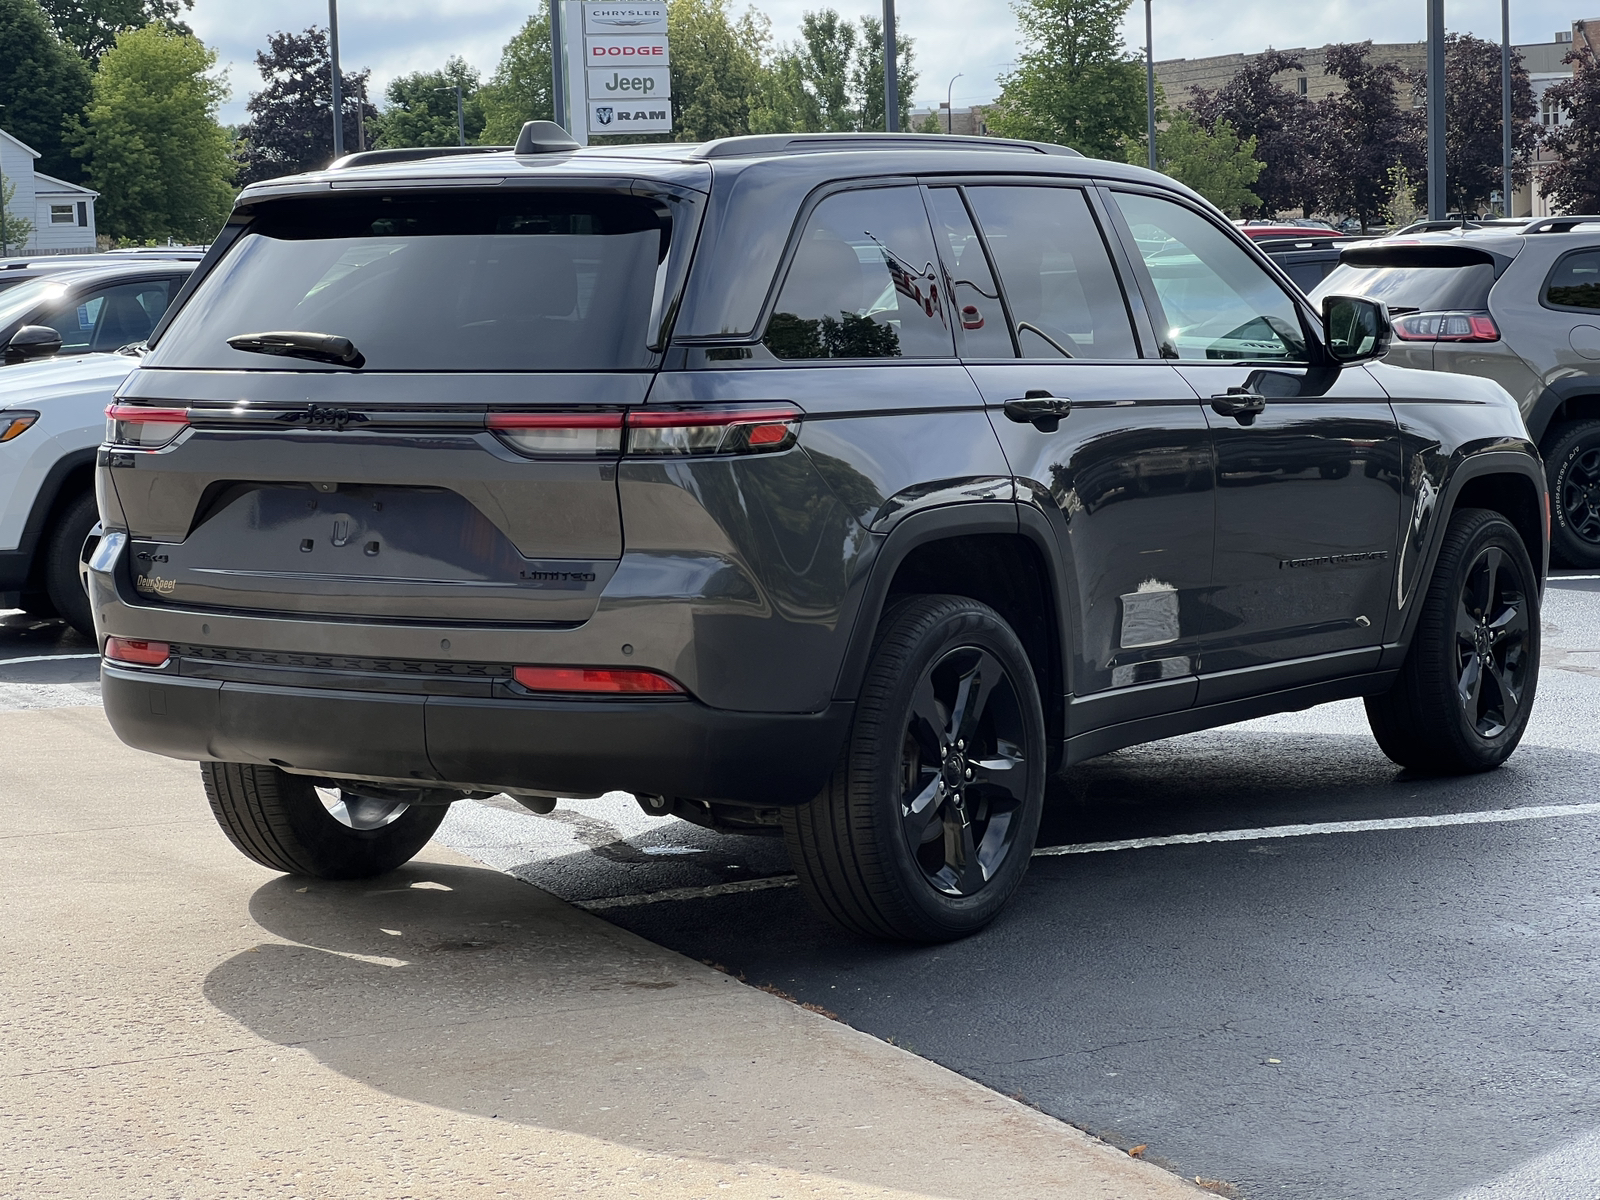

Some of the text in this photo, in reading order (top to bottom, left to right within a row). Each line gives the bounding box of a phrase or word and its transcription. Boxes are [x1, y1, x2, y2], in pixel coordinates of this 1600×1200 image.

[593, 46, 664, 56] DODGE
[605, 73, 655, 94] Jeep
[617, 111, 666, 120] RAM
[300, 403, 349, 432] Jeep
[519, 570, 596, 582] LIMITED
